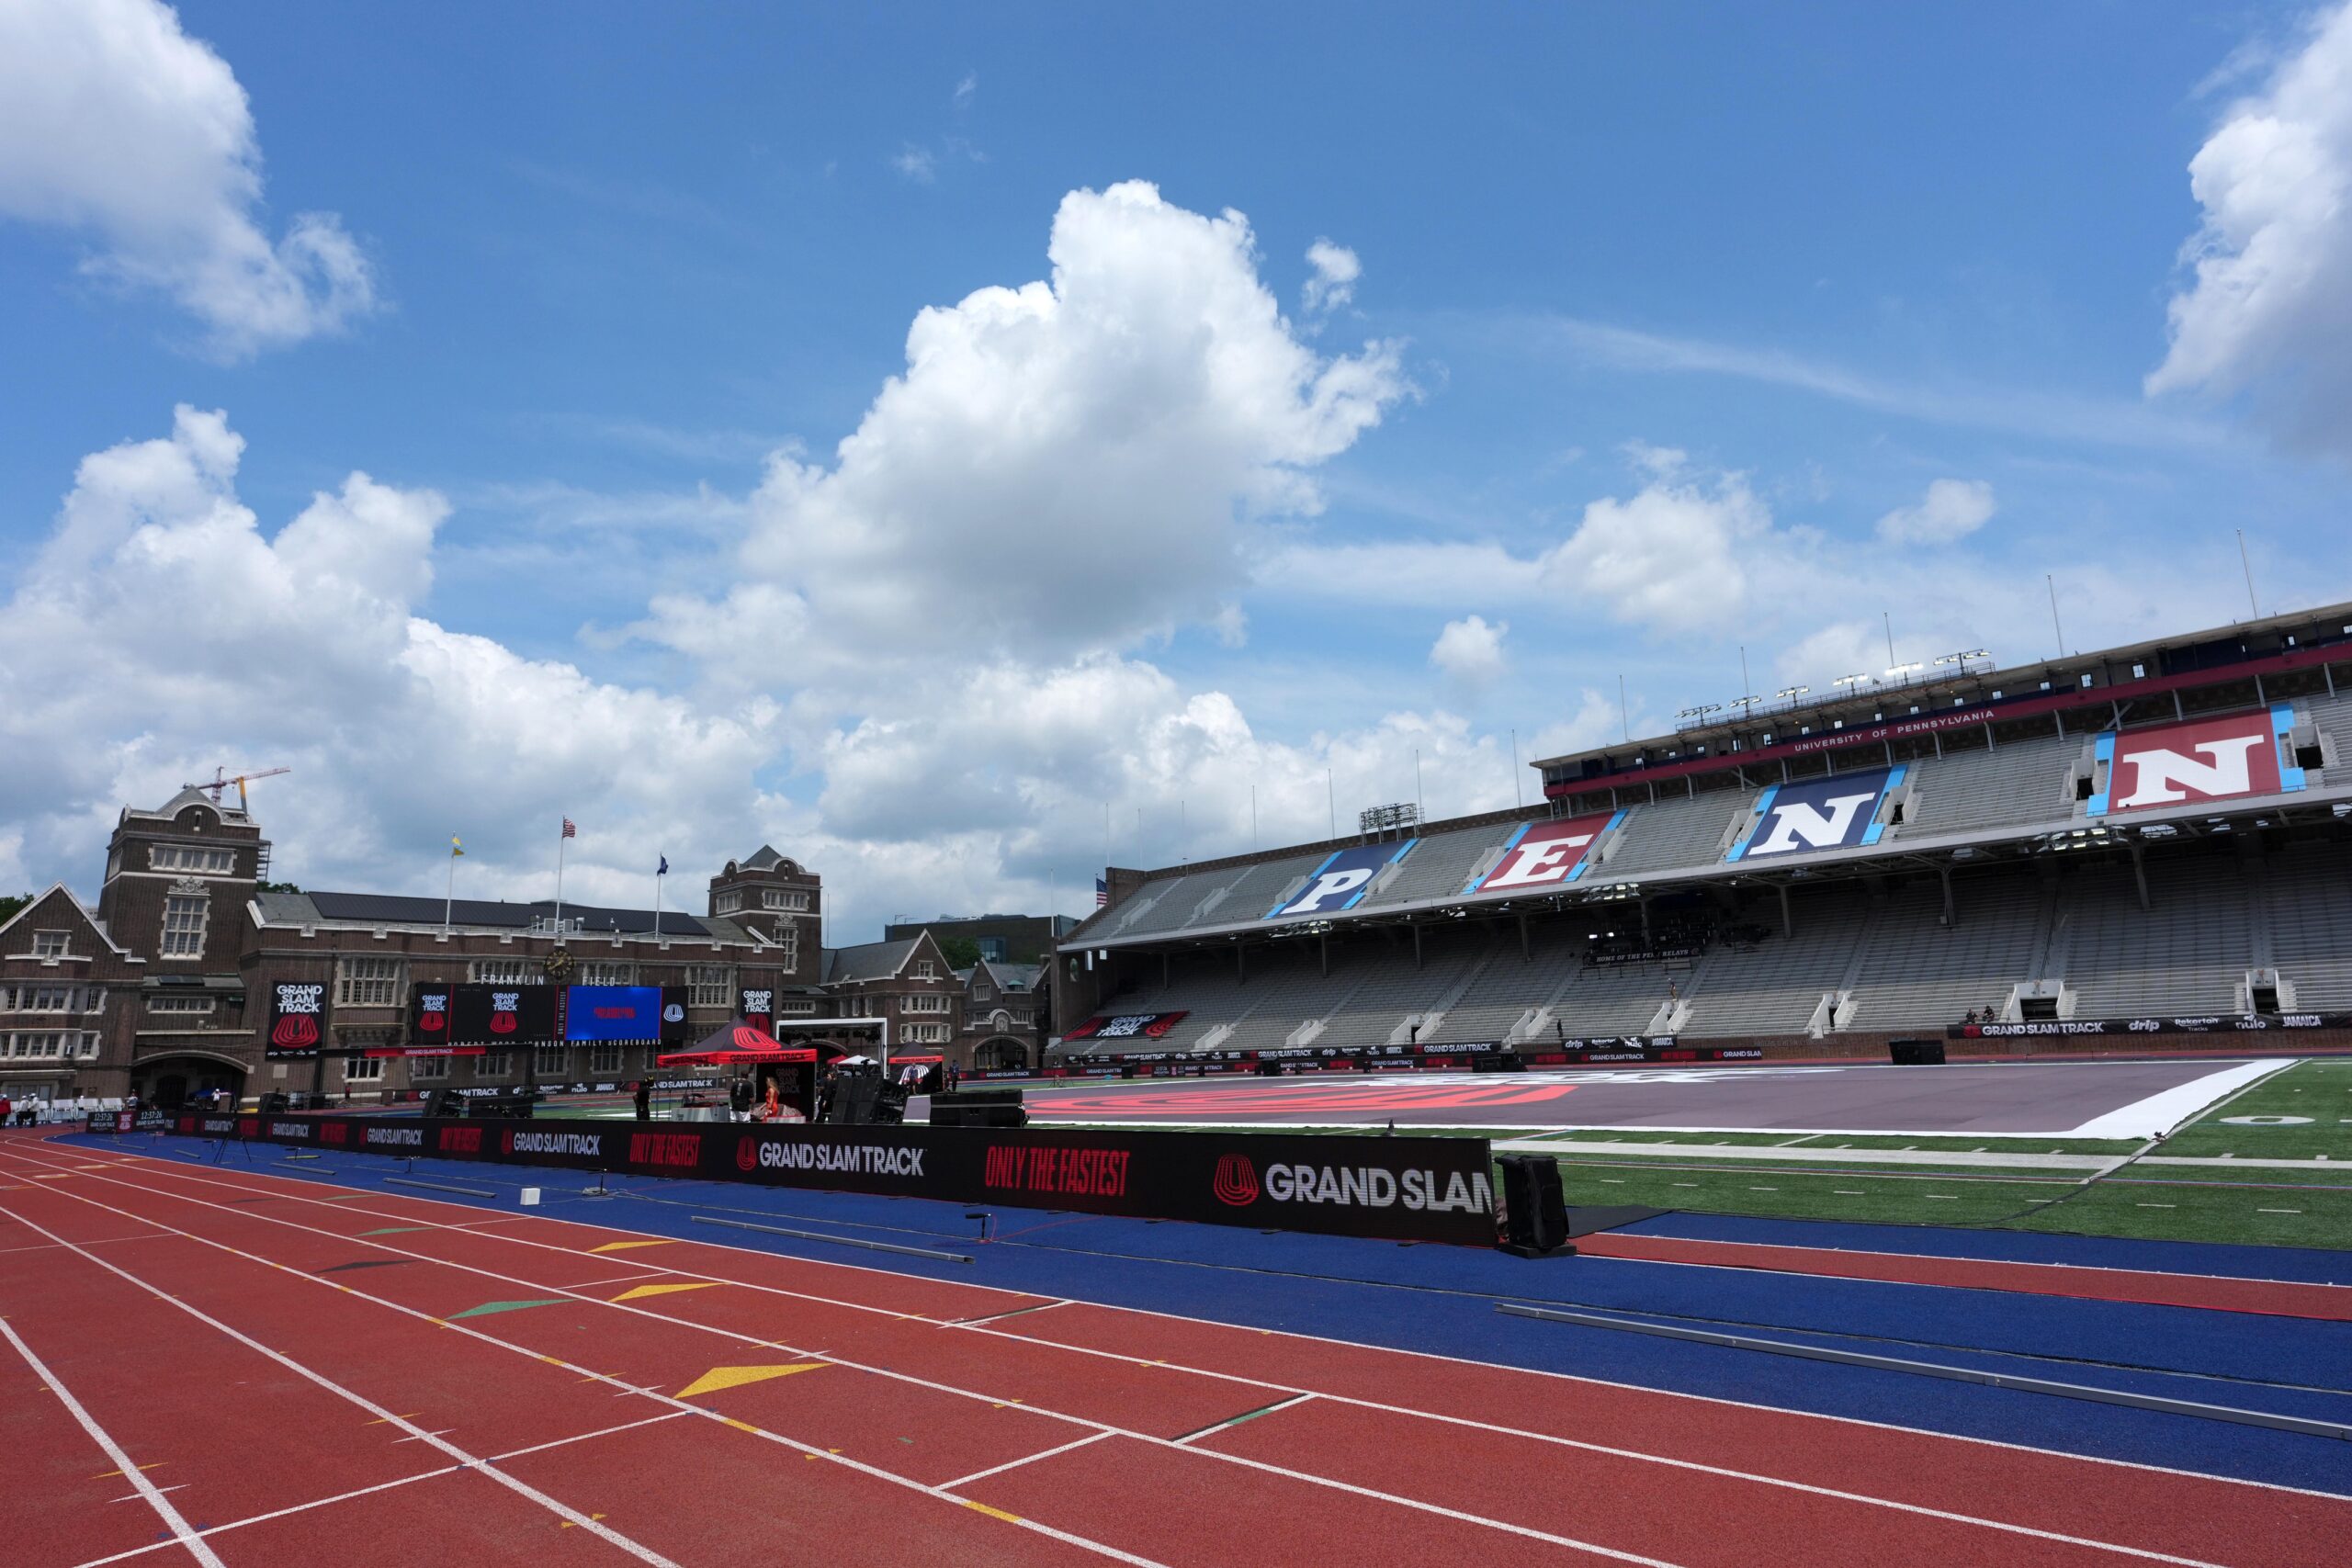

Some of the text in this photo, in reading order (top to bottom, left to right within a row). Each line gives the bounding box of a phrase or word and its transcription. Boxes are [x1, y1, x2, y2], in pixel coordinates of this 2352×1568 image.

[1794, 710, 1995, 751] UNIVERSITY OF PENNSYLVANIA
[1662, 949, 1689, 957] RELAYS
[481, 974, 616, 987] FRANKLIN FIELD
[277, 985, 322, 995] GRAND
[742, 990, 772, 998] GRAND
[281, 994, 315, 1004] SLAM
[746, 998, 767, 1006] SLAM
[277, 1002, 320, 1013] TRACK
[744, 1004, 771, 1013] TRACK
[1111, 1014, 1157, 1024] GRAND
[2174, 1017, 2220, 1026] Rekortan
[2282, 1015, 2322, 1027] JAMAICA
[1110, 1021, 1142, 1030] SLAM
[1982, 1021, 2104, 1036] GRAND SLAM TRACK
[2128, 1020, 2160, 1032] drip
[2235, 1020, 2267, 1030] nulo
[1096, 1027, 1140, 1037] TRACK
[607, 1038, 662, 1046] SCOREBOARD
[1467, 1043, 1491, 1051] TRACK
[1565, 1039, 1584, 1050] drip
[1322, 1048, 1336, 1056] drip
[1723, 1050, 1746, 1058] GRAND
[729, 1052, 806, 1063] GRAND SLAM TRACK
[1589, 1054, 1610, 1062] GRAND
[668, 1080, 687, 1089] SLAM
[687, 1079, 713, 1088] TRACK
[471, 1088, 498, 1097] TRACK
[368, 1127, 423, 1145] GRAND SLAM TRACK
[514, 1132, 601, 1156] GRAND SLAM TRACK
[629, 1132, 701, 1168] ONLY THE FASTEST
[759, 1142, 924, 1177] GRAND SLAM TRACK
[985, 1145, 1130, 1197] ONLY THE FASTEST
[1265, 1162, 1397, 1209] GRAND
